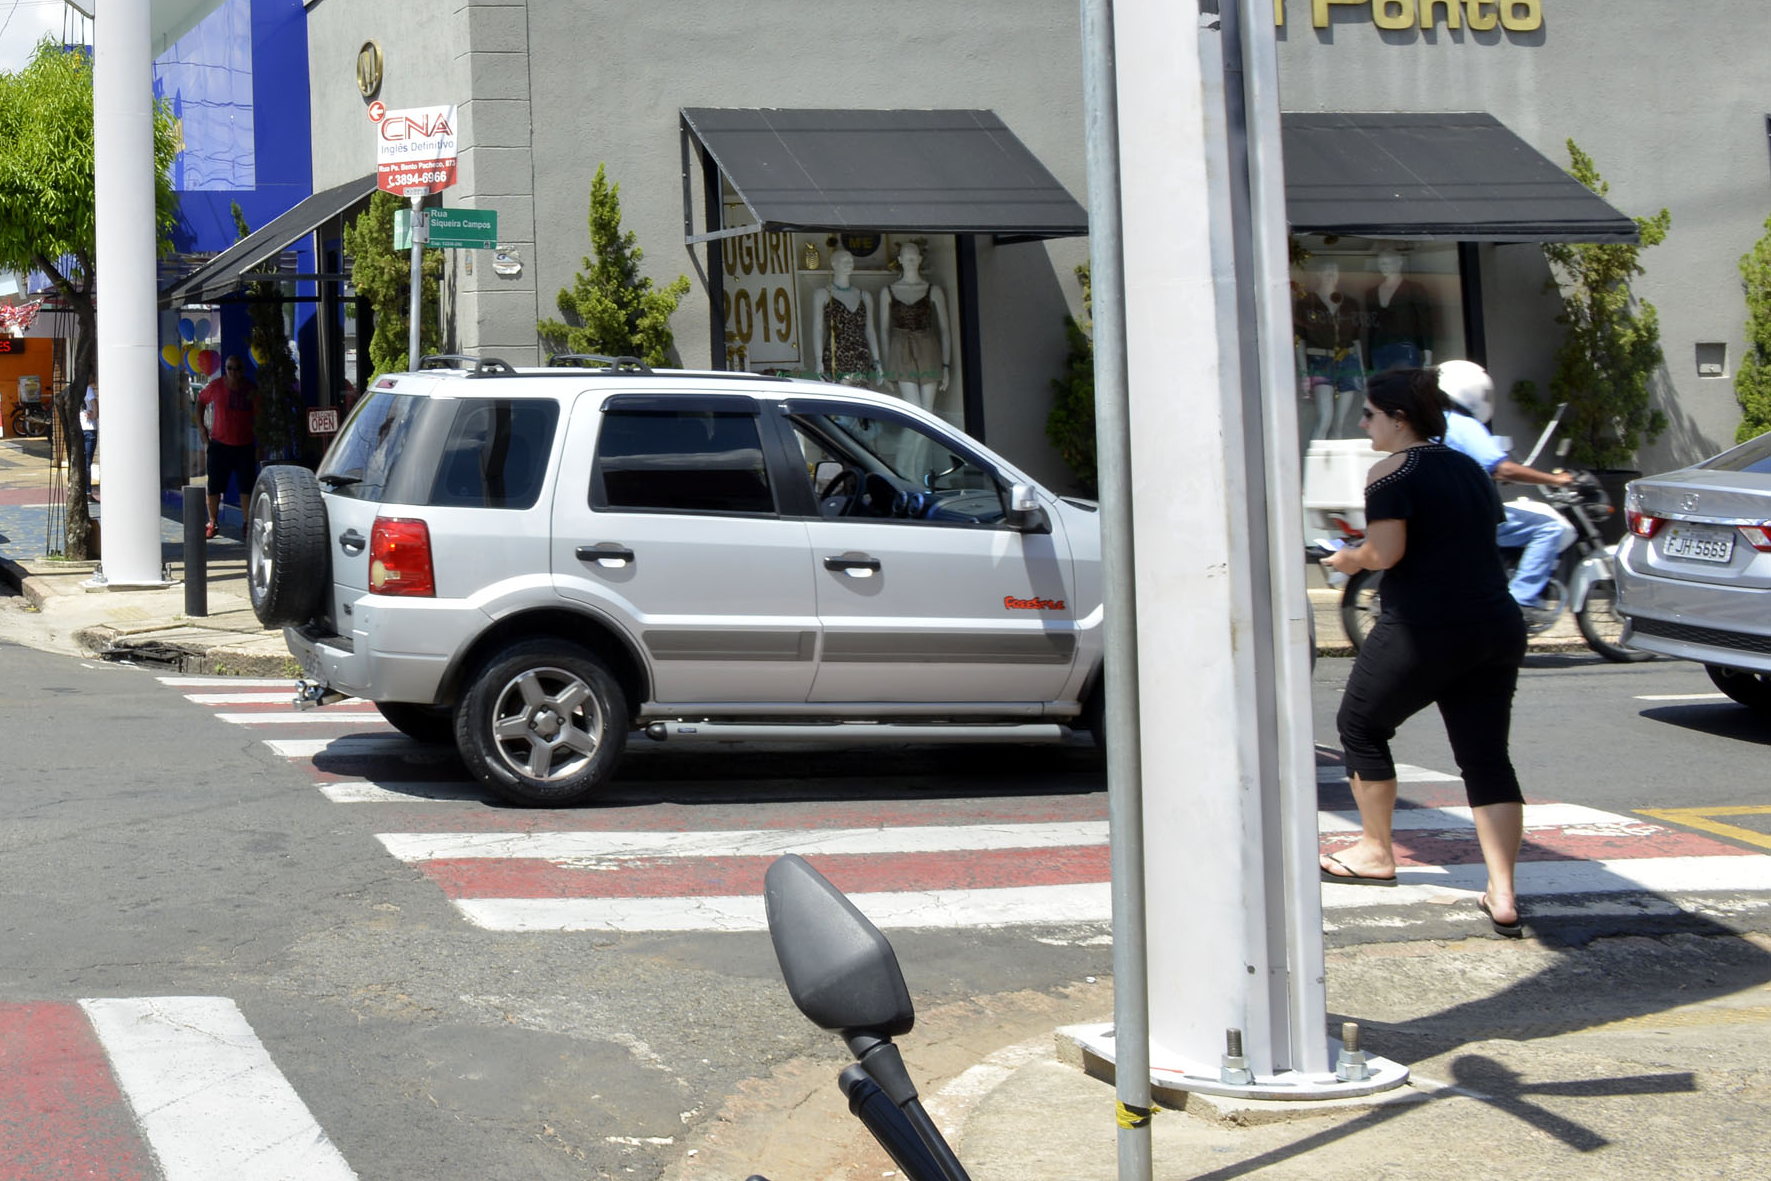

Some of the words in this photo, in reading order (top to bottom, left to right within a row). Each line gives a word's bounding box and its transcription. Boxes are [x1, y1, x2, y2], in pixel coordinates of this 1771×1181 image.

[381, 113, 454, 141] CNA
[381, 143, 408, 156] Inglês
[411, 140, 454, 152] Definitivo
[395, 171, 447, 186] 3894-6966
[431, 210, 448, 218] Rua
[431, 219, 461, 228] Siqueira
[463, 220, 491, 229] Campos
[312, 418, 335, 431] OPEN
[1668, 537, 1728, 559] FJH-5669
